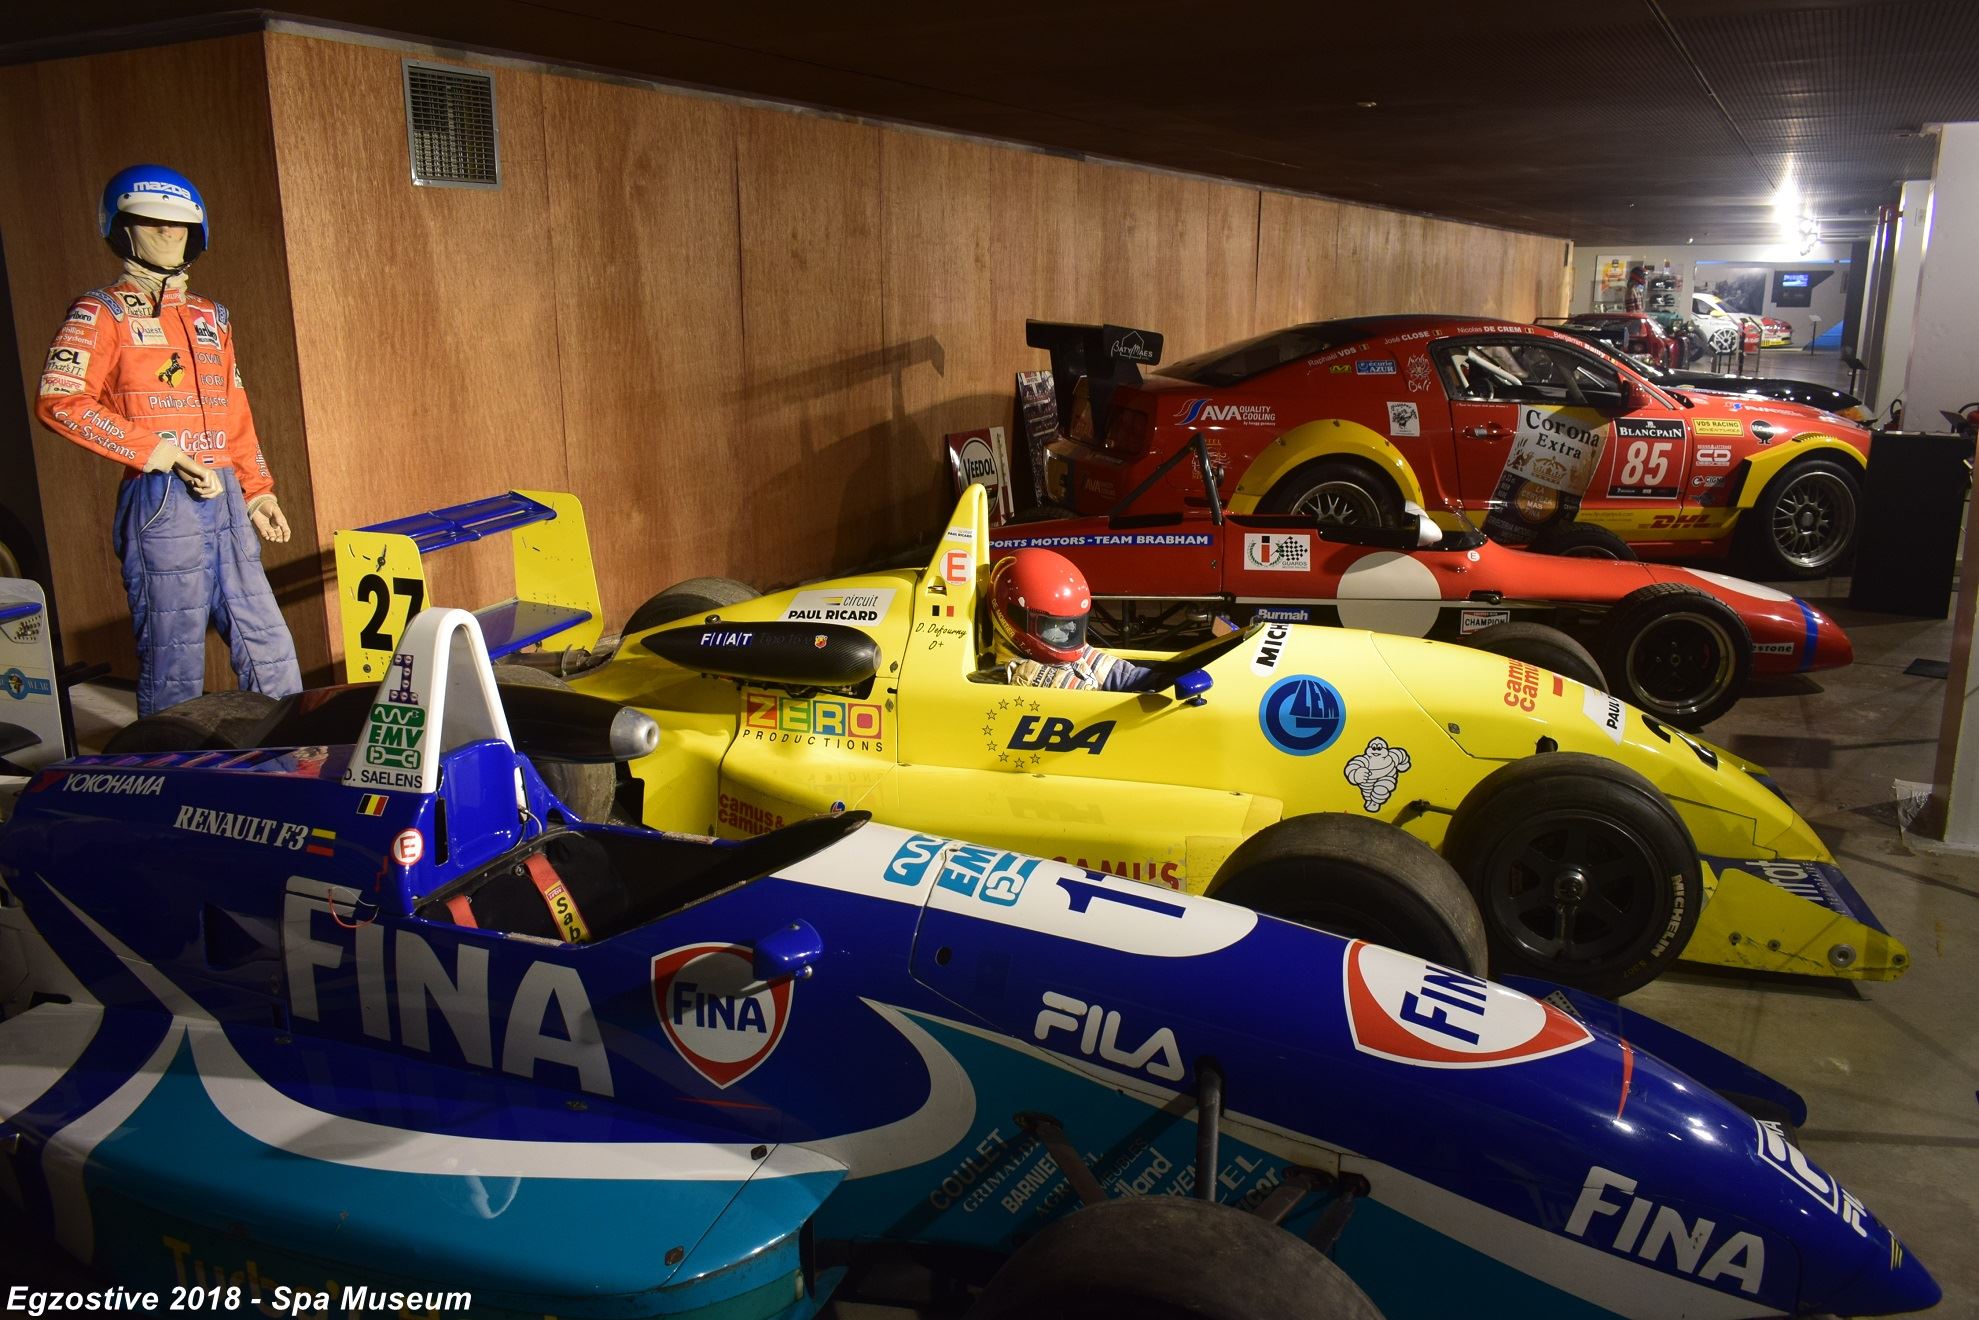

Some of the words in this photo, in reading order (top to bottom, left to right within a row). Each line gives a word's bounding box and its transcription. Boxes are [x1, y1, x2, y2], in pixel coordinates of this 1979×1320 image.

[133, 181, 191, 199] mazda
[1401, 331, 1431, 341] CLOSE
[82, 408, 126, 440] Philips
[1201, 406, 1242, 420] AVA
[1243, 413, 1276, 421] COOLING
[79, 424, 137, 460] Systems
[1526, 409, 1600, 448] Corona
[1620, 427, 1683, 438] BLANCPAIN
[1536, 433, 1582, 460] Extra
[963, 458, 995, 480] VEEDOL
[1621, 441, 1672, 486] 85
[1650, 515, 1710, 528] DHL
[989, 539, 1027, 549] PORTS
[1031, 536, 1086, 547] MOTORS
[1094, 536, 1133, 545] TEAM
[1136, 535, 1209, 545] BRABHAM
[947, 553, 967, 582] E
[357, 573, 424, 651] 27
[842, 594, 879, 607] circuit
[788, 610, 822, 620] PAUL
[824, 610, 878, 621] RICARD
[1258, 608, 1308, 621] Burmah
[746, 693, 882, 739] ZERO
[368, 724, 424, 749] EMV
[742, 729, 883, 752] PRODUCTIONS
[1006, 715, 1117, 755] EBA
[62, 774, 166, 795] YOKOHAMA
[361, 769, 423, 789] SAELENS
[173, 805, 278, 844] RENAULT
[274, 822, 309, 851] F3
[400, 835, 416, 859] E
[557, 897, 581, 942] Sab
[1651, 874, 1687, 958] MICHELIN
[283, 875, 615, 1097] FINA
[673, 981, 767, 1034] FINA
[1400, 964, 1488, 1045] FIN
[1034, 990, 1185, 1081] FILA
[1564, 1166, 1765, 1294] FINA
